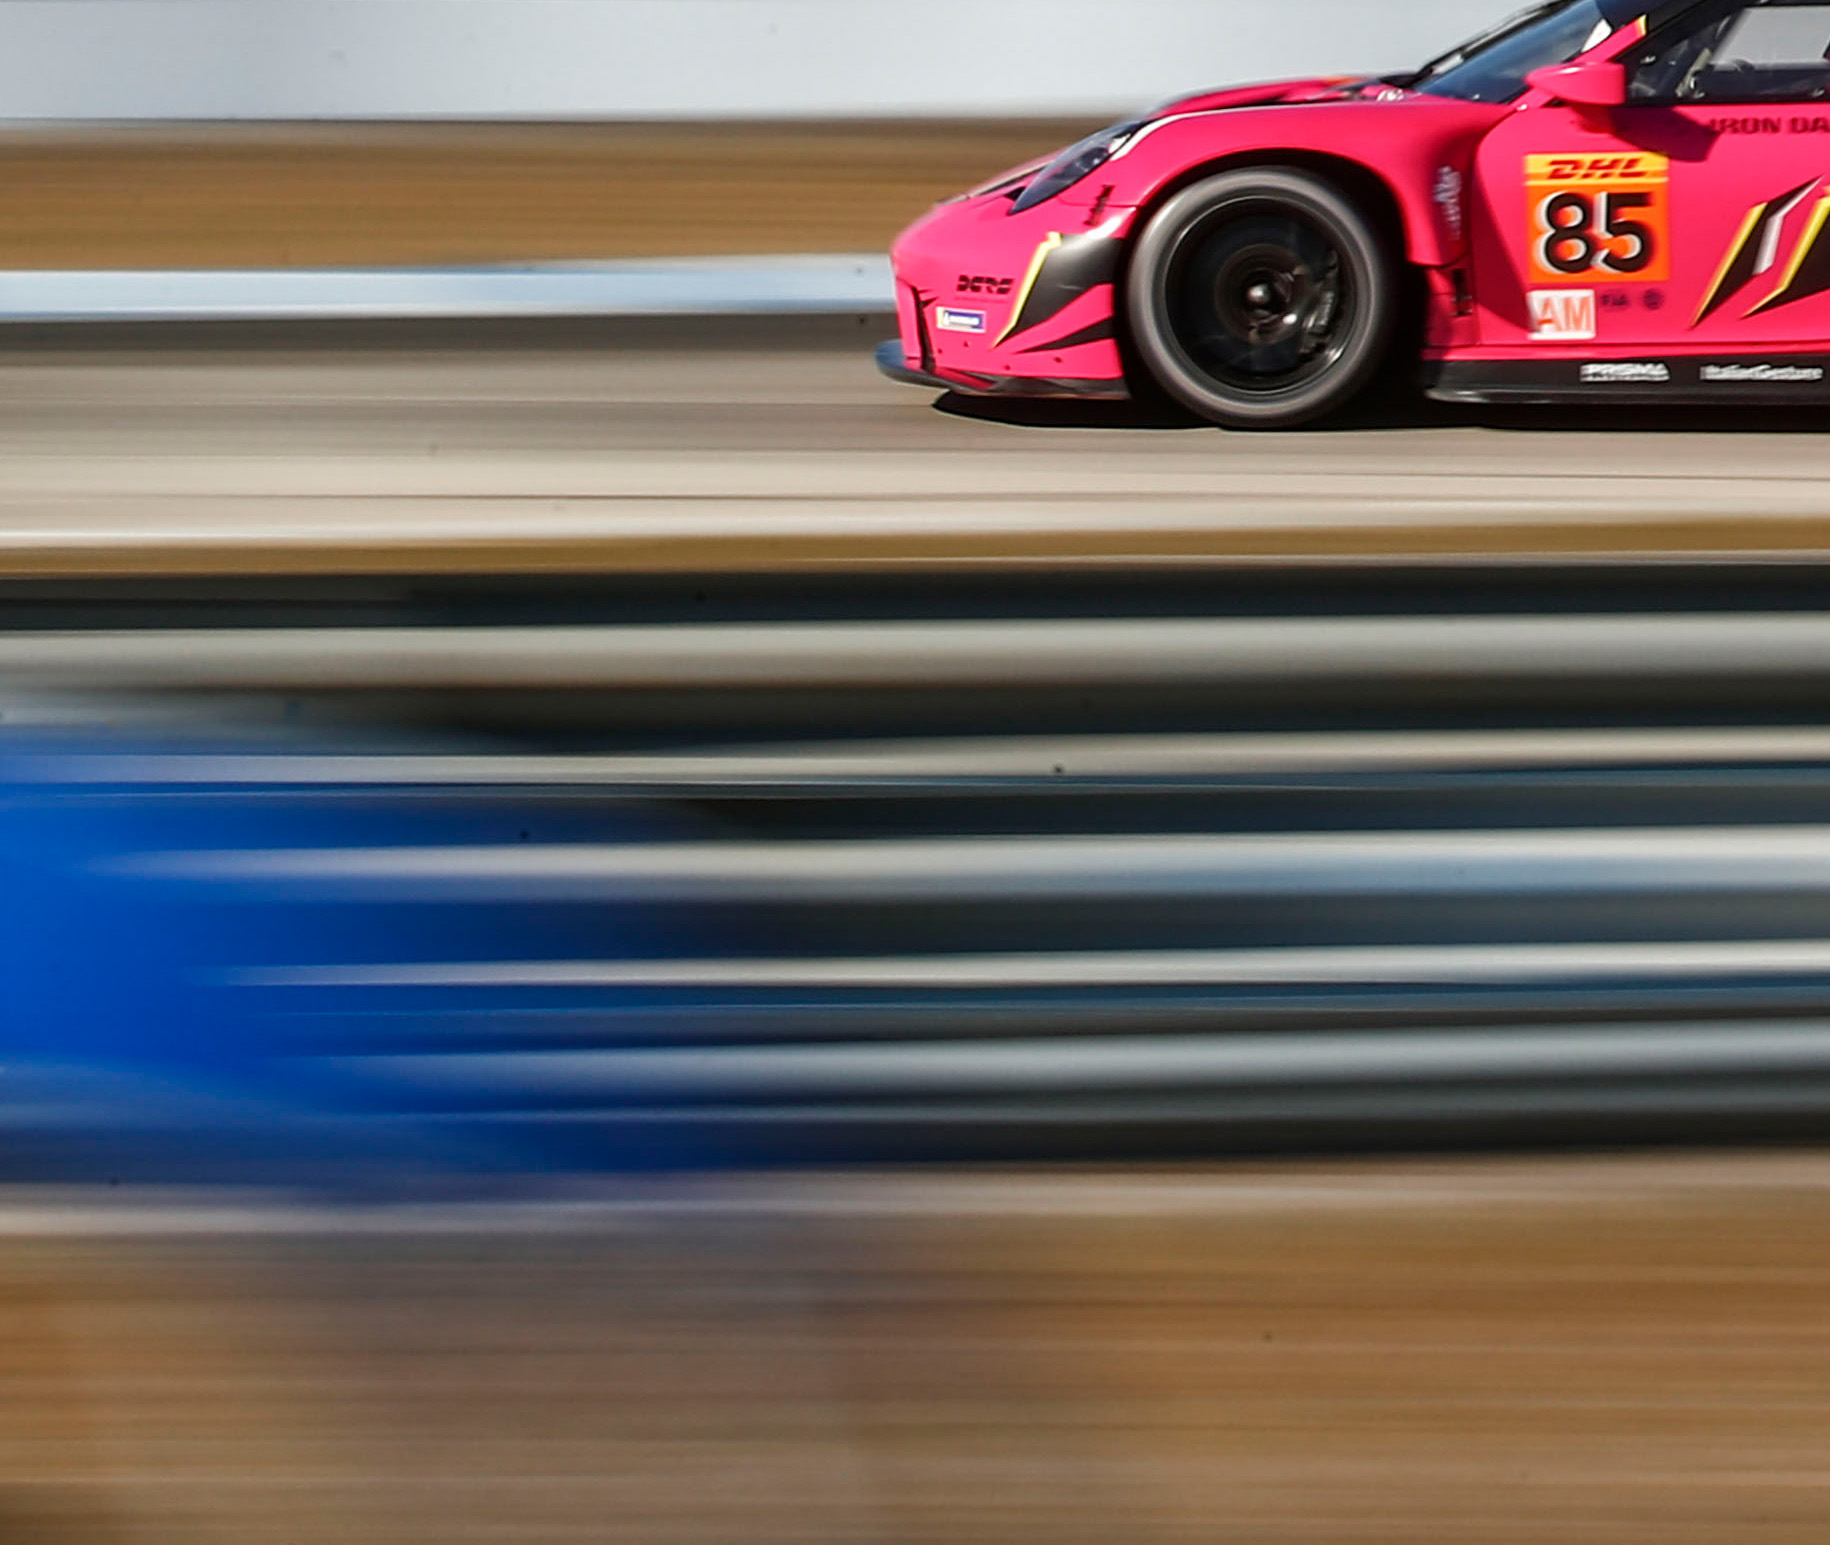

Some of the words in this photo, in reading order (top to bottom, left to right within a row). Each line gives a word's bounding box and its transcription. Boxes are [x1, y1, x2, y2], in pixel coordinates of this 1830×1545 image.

[1709, 116, 1782, 135] IRON
[1546, 157, 1652, 180] DHL
[1540, 190, 1653, 274] 85
[1538, 296, 1592, 333] AM
